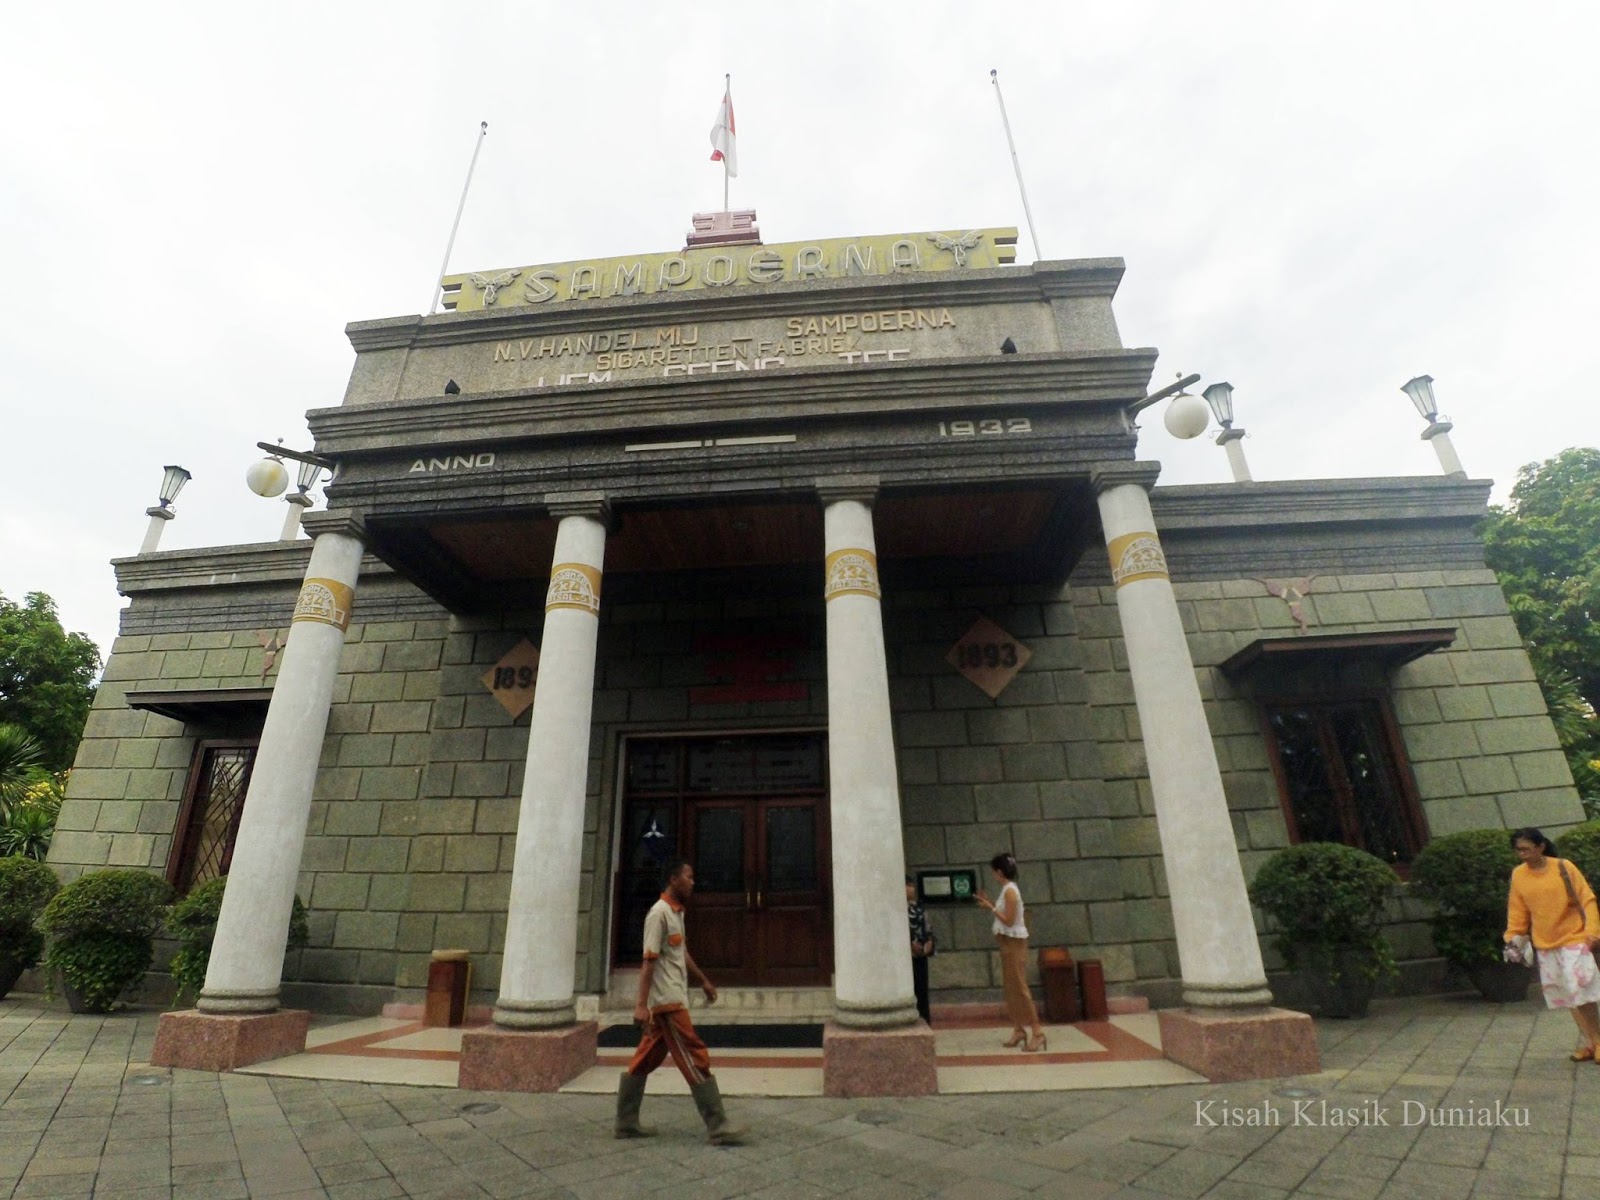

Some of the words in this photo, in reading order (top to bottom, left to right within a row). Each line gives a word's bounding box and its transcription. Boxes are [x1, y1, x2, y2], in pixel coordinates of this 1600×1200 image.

[524, 239, 921, 304] SAMPOERNA
[786, 307, 956, 338] SAMPOERNA
[596, 344, 748, 371] SIGARETTEN
[937, 417, 1032, 437] 1932
[409, 452, 496, 473] ANNO
[957, 642, 1018, 668] 1893
[493, 666, 537, 690] 189
